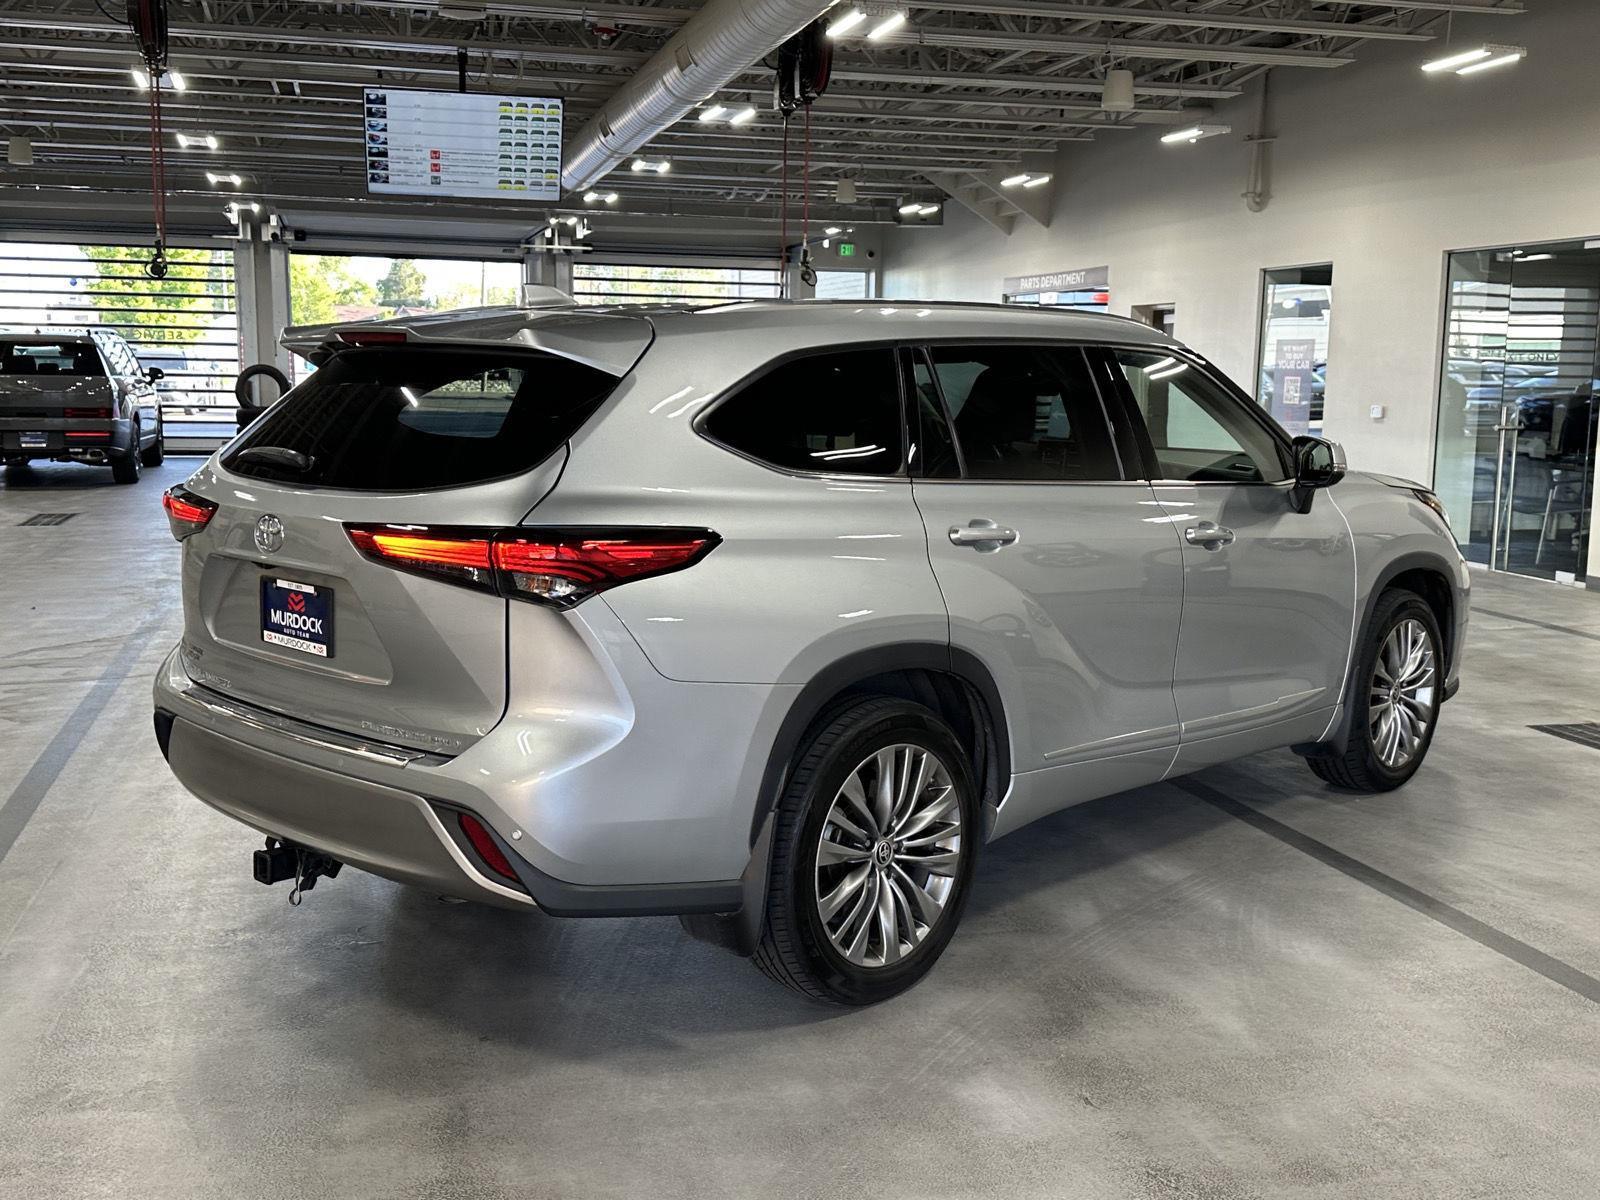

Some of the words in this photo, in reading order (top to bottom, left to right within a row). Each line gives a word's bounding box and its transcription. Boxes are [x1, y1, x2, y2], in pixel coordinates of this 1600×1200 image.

[1020, 276, 1040, 289] PARTS
[1040, 271, 1086, 288] DEPARTMENT
[1528, 352, 1560, 361] ONLY
[1278, 360, 1295, 369] YOUR
[1296, 360, 1310, 369] CAR
[270, 608, 323, 635] MURDOCK
[283, 627, 296, 636] AUTO
[296, 630, 310, 639] TEAM
[277, 636, 312, 651] MURDOCK
